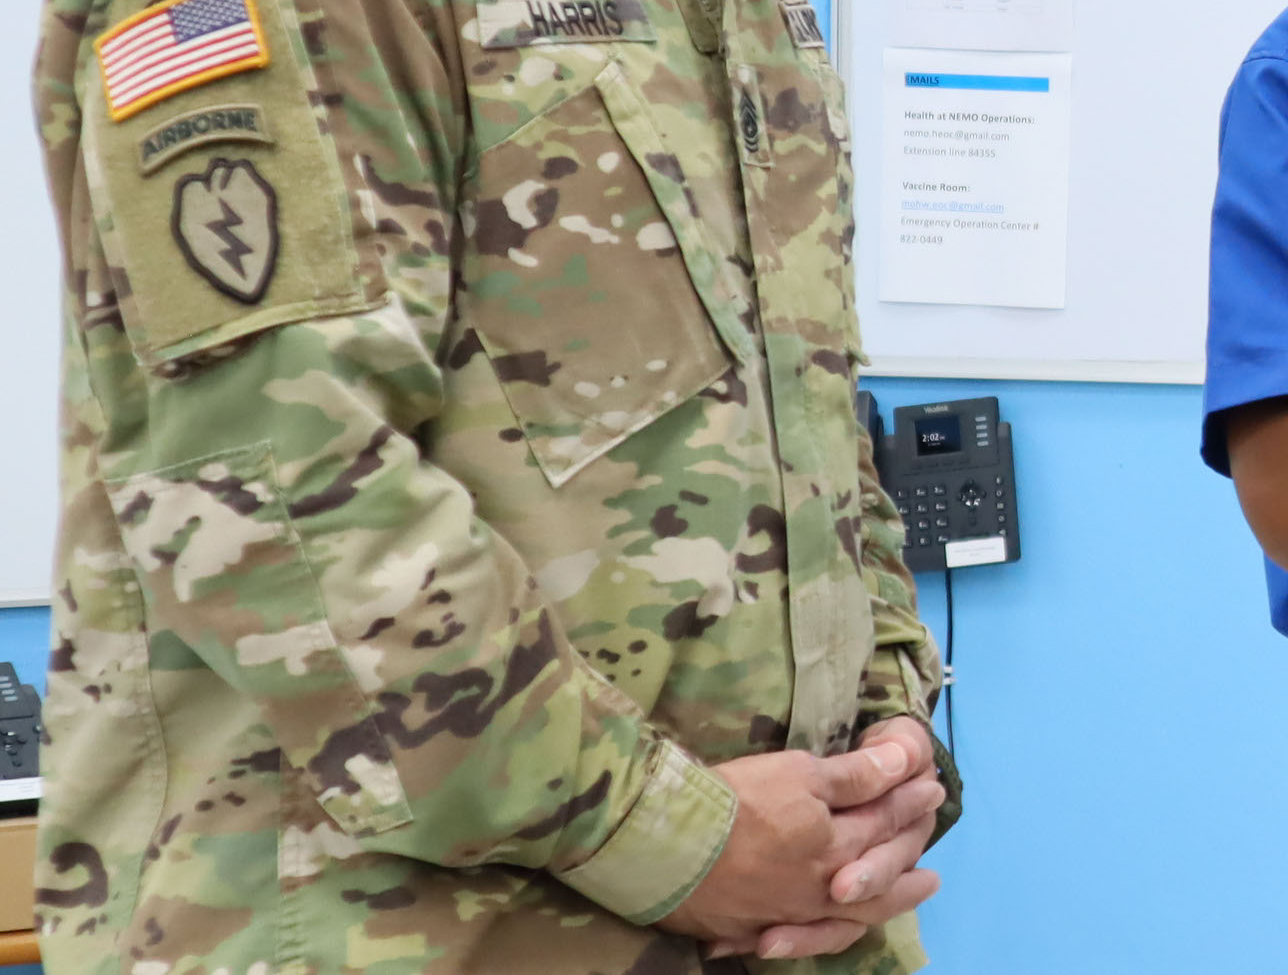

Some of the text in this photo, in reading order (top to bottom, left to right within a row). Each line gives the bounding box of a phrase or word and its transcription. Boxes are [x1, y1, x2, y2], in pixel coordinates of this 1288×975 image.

[526, 0, 624, 38] HARRIS
[904, 110, 1035, 126] Health at NEMO Operations:
[143, 110, 257, 162] AIRBORNE
[903, 129, 1010, 142] nemo.heoc@gmail.com
[903, 146, 947, 157] Extension
[949, 147, 966, 157] line
[902, 181, 971, 193] Vaccine Room:
[901, 200, 1005, 213] mohw.eoc@gmail.com
[900, 217, 951, 229] Emergency
[953, 218, 999, 230] Operation
[1000, 220, 1031, 231] Center
